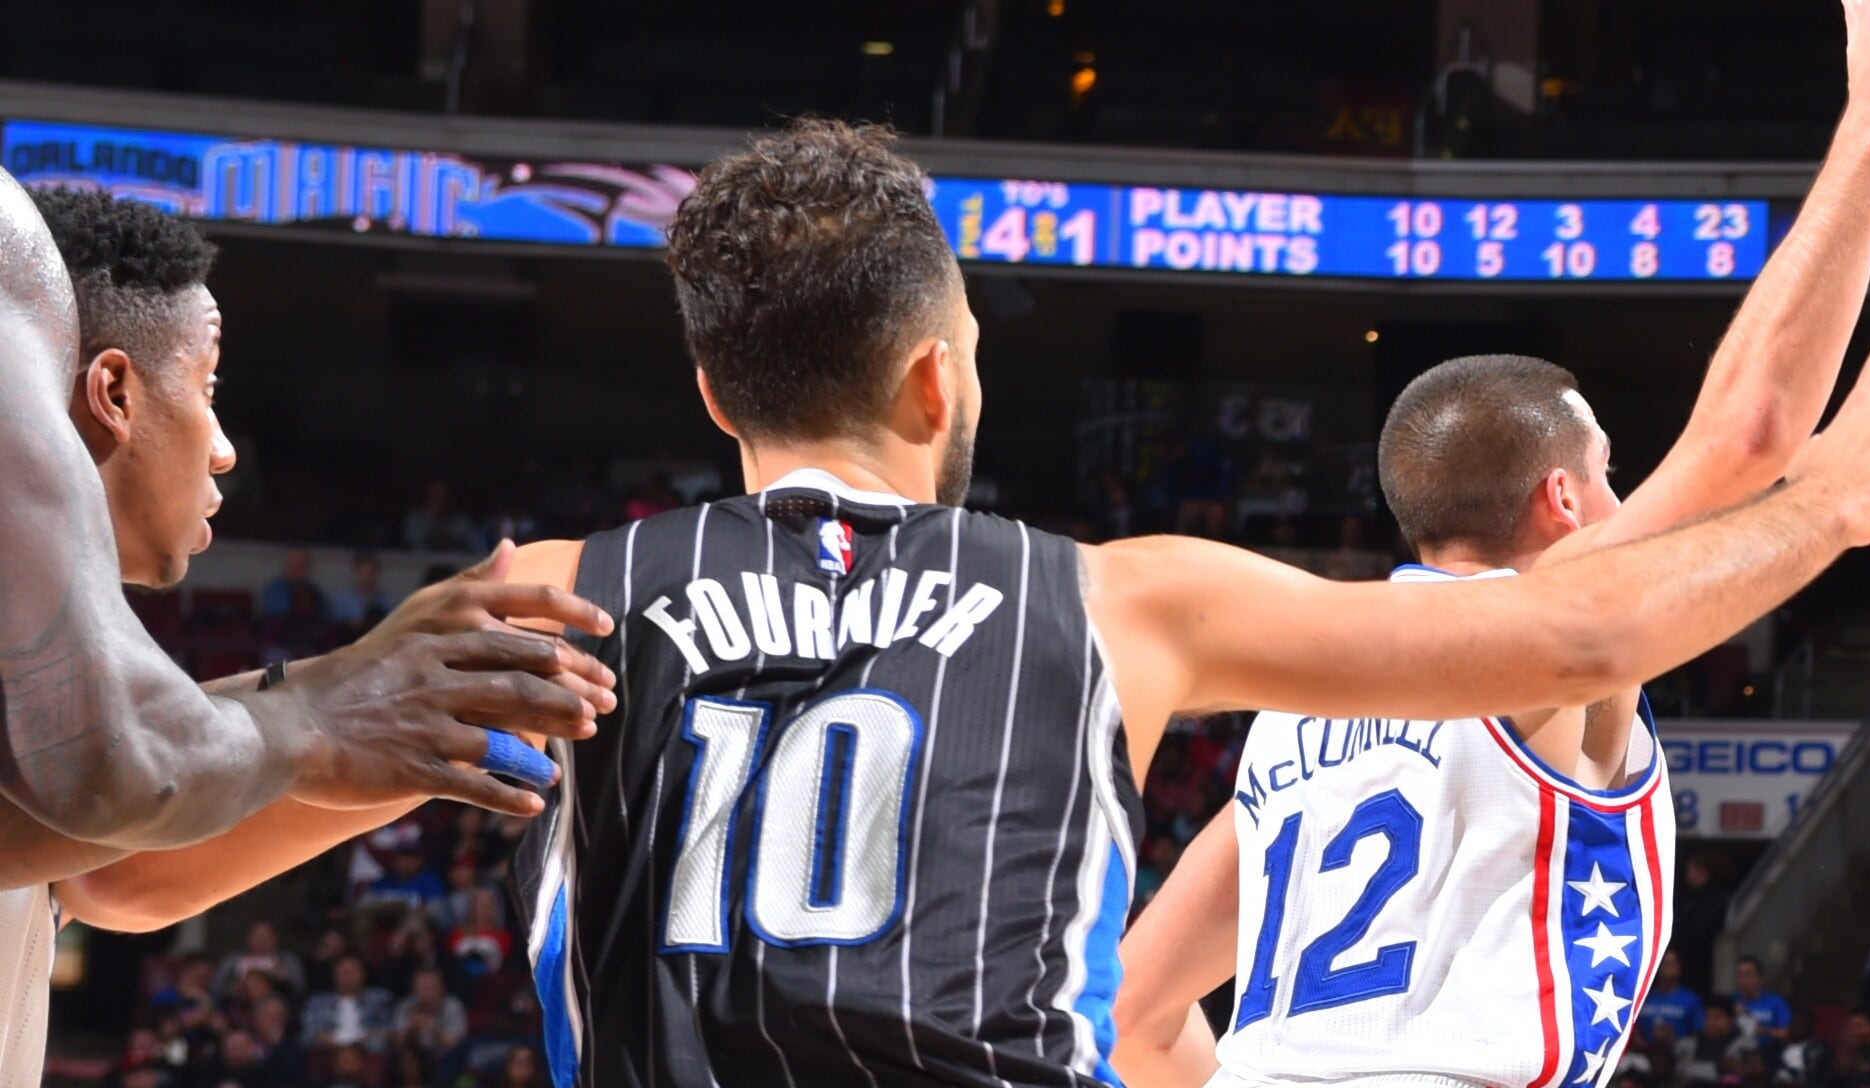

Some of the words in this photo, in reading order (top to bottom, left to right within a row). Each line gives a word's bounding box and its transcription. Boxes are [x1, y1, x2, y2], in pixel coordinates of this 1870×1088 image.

[13, 142, 198, 188] ORLANDO
[203, 139, 481, 236] MAGIC
[982, 208, 1030, 261] 4
[1061, 210, 1095, 265] 1
[1130, 187, 1323, 236] PLAYER
[1388, 201, 1443, 237] 10
[1465, 204, 1518, 239] 12
[1555, 204, 1583, 239] 3
[1630, 204, 1660, 239] 4
[1694, 204, 1749, 239] 23
[1132, 230, 1319, 275] POINTS
[1388, 239, 1441, 275] 10
[1476, 243, 1504, 277] 5
[1541, 243, 1596, 277] 10
[1630, 243, 1659, 277] 8
[1705, 243, 1735, 277] 8
[643, 568, 1004, 674] FOURNIER
[1660, 740, 1836, 775] GEICO
[657, 688, 924, 954] 10
[1233, 788, 1423, 1034] 12
